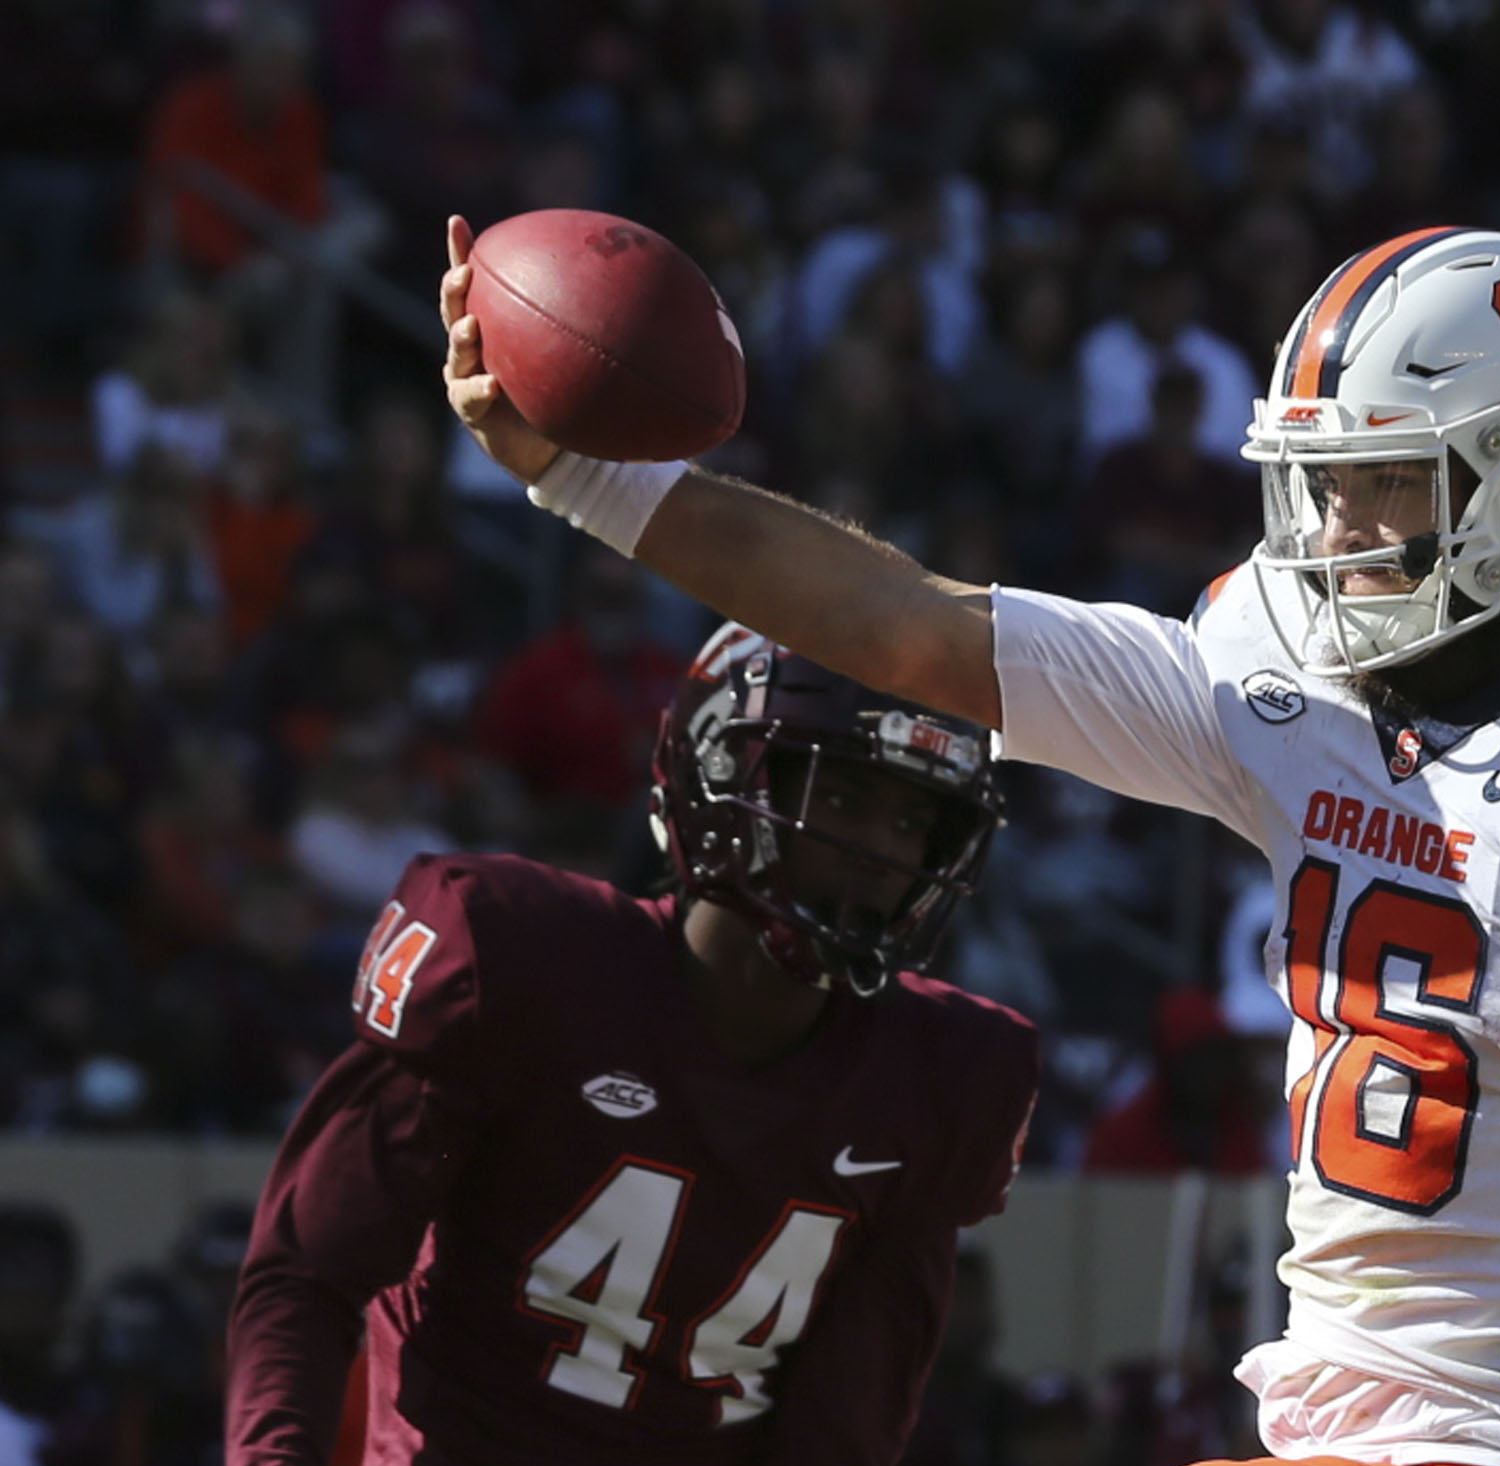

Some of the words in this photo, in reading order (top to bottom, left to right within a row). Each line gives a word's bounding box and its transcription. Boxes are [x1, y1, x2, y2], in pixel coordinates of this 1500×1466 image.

[1253, 681, 1302, 710] ACC
[1389, 729, 1422, 778] S
[1303, 789, 1476, 883] ORANGE
[1282, 854, 1489, 1217] 16
[591, 1083, 650, 1105] ACC
[514, 1153, 858, 1428] 44
